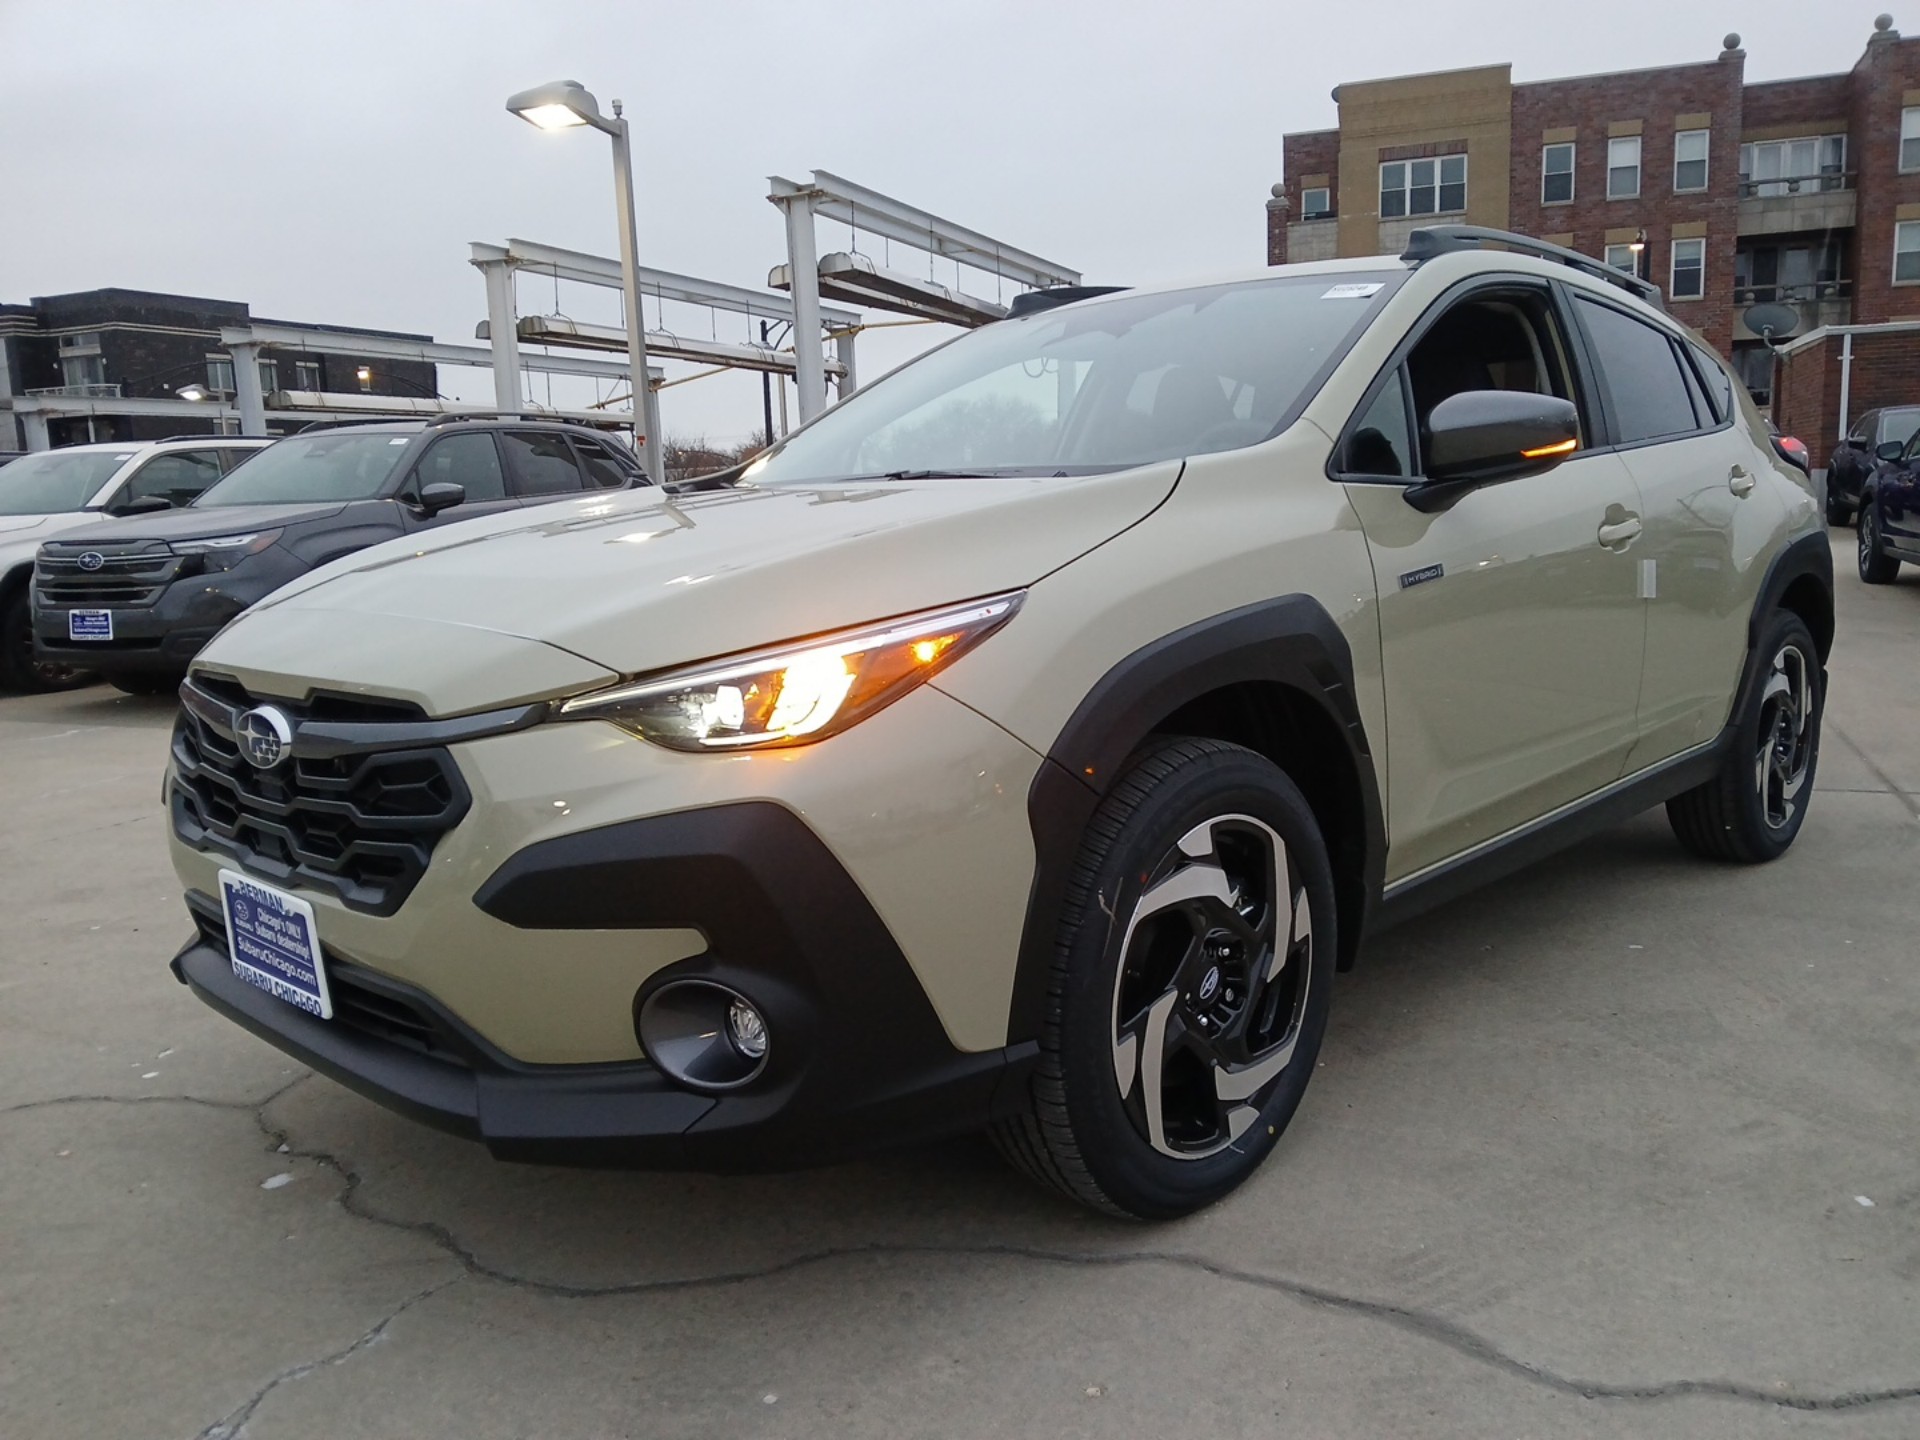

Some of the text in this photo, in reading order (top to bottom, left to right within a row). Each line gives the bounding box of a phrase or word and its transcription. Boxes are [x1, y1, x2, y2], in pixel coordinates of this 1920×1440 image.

[238, 880, 284, 914] BERMAN
[255, 922, 277, 942] Subaru
[237, 936, 317, 987] SubaruChicago.com
[233, 961, 322, 1016] SUBARU CHICAGO
